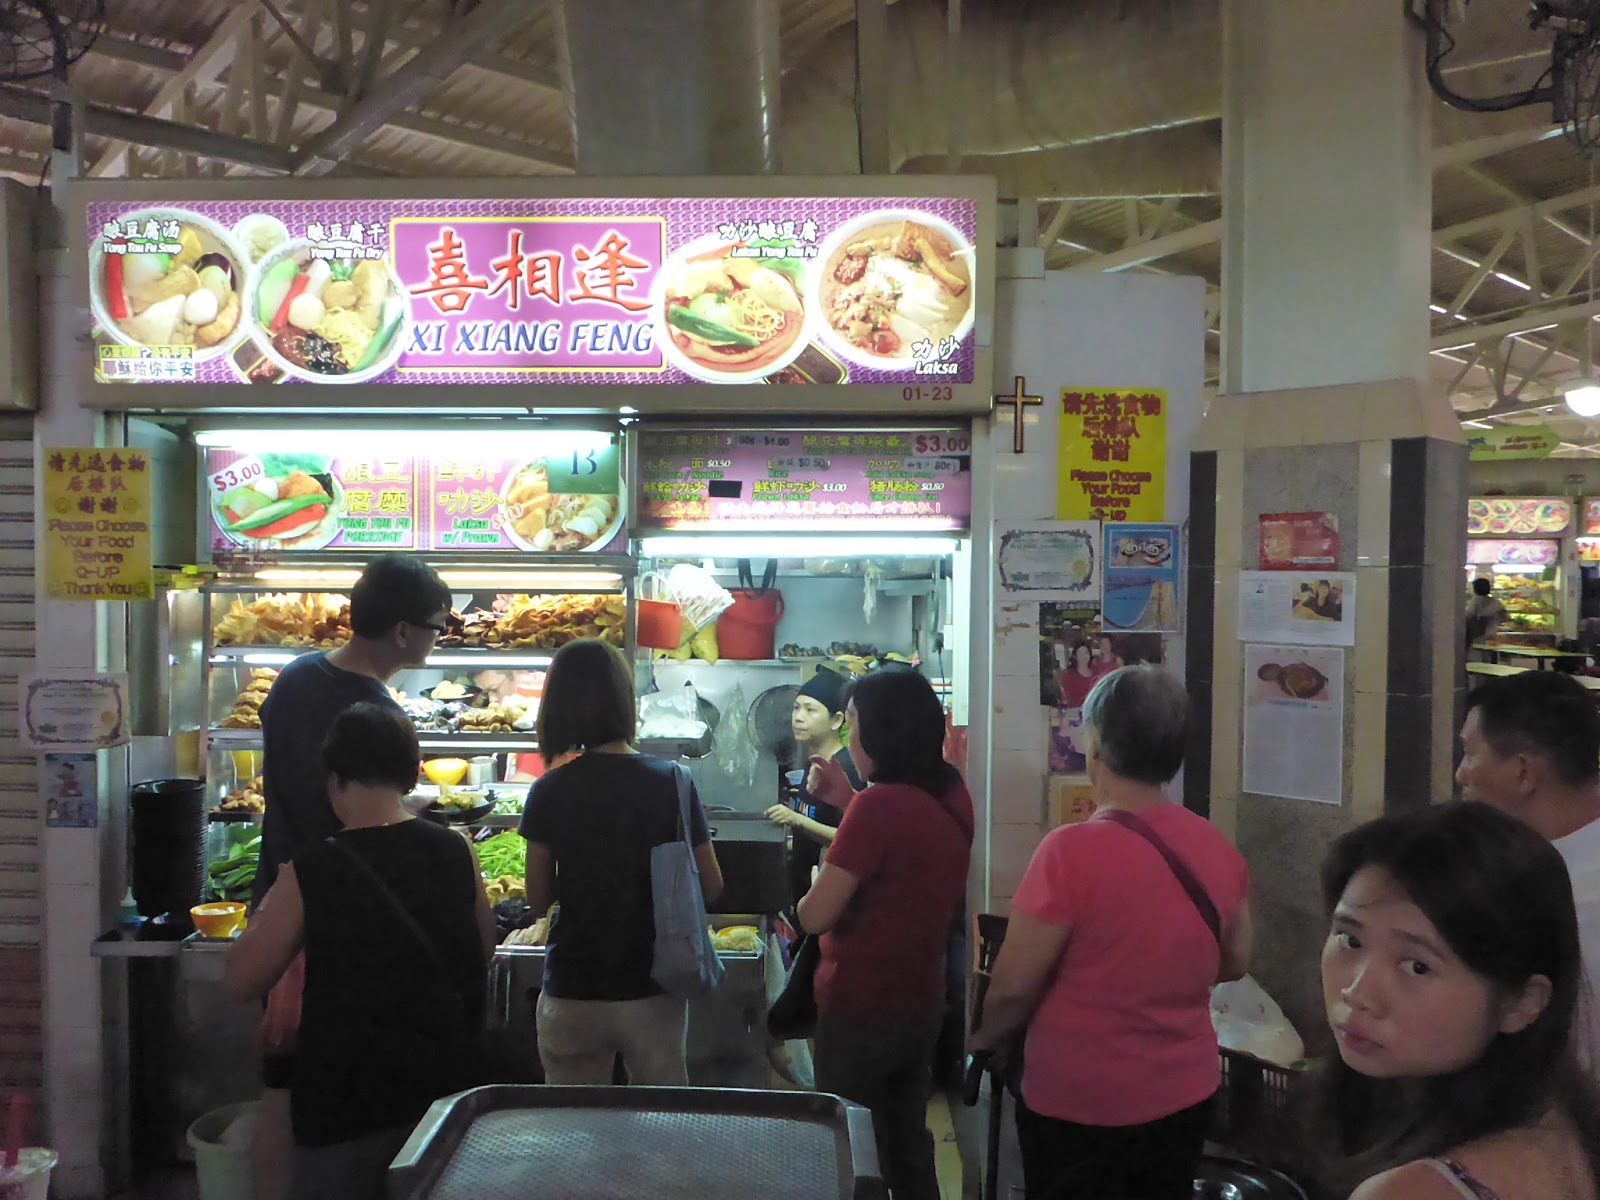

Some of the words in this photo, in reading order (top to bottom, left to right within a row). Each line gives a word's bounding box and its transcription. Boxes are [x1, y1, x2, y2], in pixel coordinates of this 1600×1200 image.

[410, 230, 653, 311] 喜相逢
[408, 324, 445, 351] XI
[455, 323, 560, 351] XIANG
[570, 323, 654, 351] FENG
[915, 361, 959, 374] Laksa
[902, 386, 953, 401] 01-23
[915, 434, 969, 454] $3.00
[213, 461, 263, 493] $3.00
[1070, 469, 1109, 481] Please
[1109, 469, 1152, 482] Choose
[822, 483, 848, 492] $3.00
[921, 482, 945, 491] $0.80
[1081, 482, 1111, 494] Your
[1111, 482, 1141, 495] Food
[1090, 495, 1131, 507] Before
[48, 519, 94, 531] Please
[96, 519, 148, 532] Choose
[452, 517, 490, 530] Laksa
[60, 535, 94, 548] Your
[98, 535, 135, 548] Food
[460, 531, 500, 544] Prawn
[64, 582, 105, 595] Thank
[107, 582, 132, 595] You
